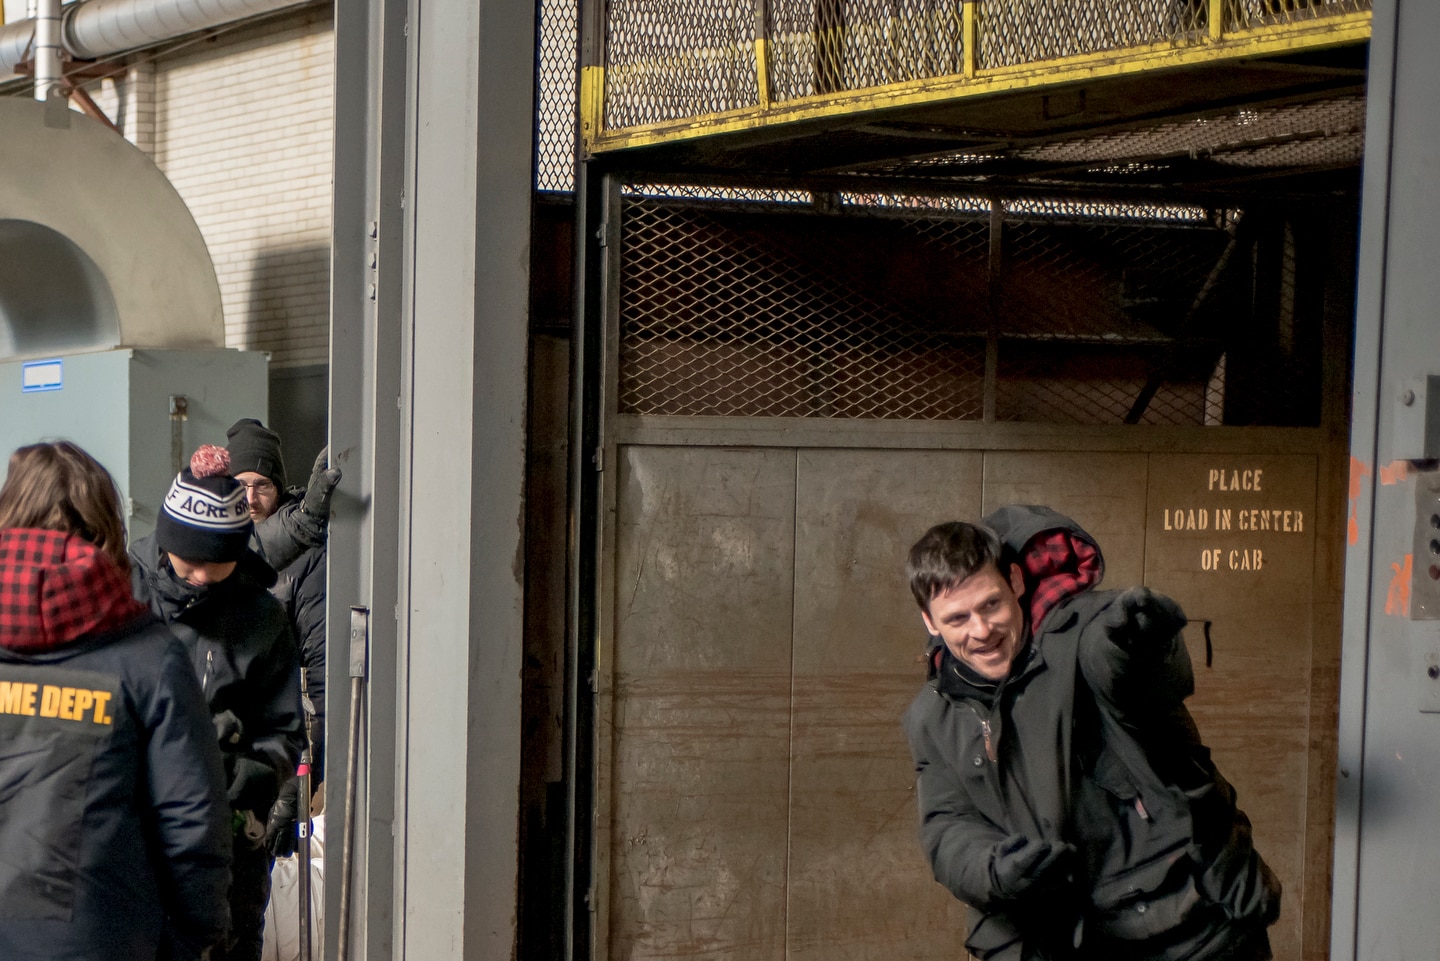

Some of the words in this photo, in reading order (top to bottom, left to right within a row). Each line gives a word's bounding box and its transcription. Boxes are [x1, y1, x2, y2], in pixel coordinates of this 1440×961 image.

[1209, 469, 1262, 491] PLACE
[180, 496, 228, 518] ACRE
[1164, 509, 1209, 531] LOAD
[1215, 509, 1231, 530] IN
[1239, 509, 1303, 532] CENTER
[1201, 549, 1222, 570] OF
[1229, 550, 1263, 570] CAB
[39, 685, 112, 725] DEPT.
